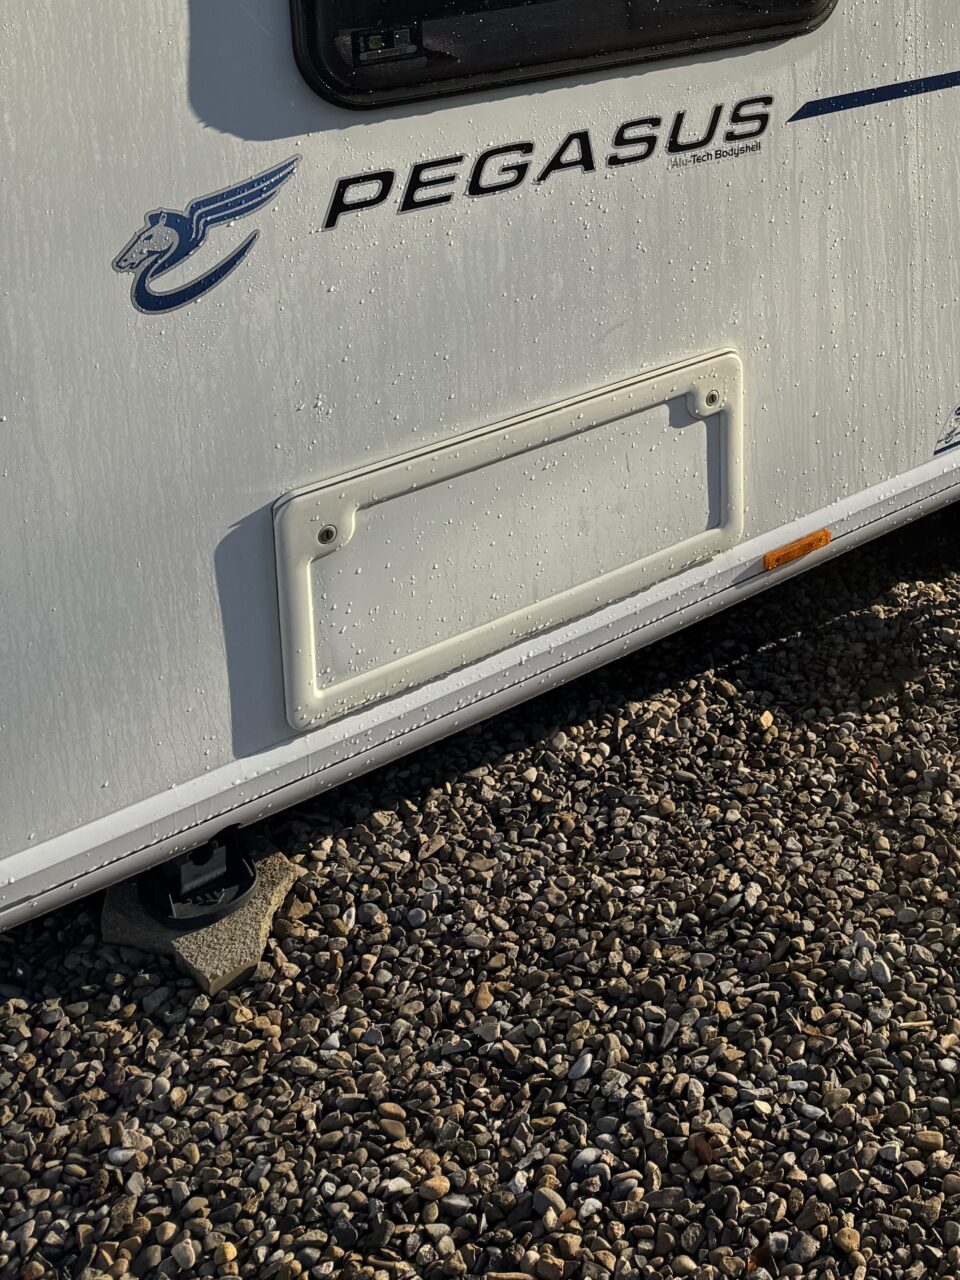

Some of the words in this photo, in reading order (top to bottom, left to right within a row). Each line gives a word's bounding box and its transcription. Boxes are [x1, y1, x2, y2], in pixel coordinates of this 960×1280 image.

[321, 95, 774, 231] PEGASUS
[670, 152, 713, 168] Alu-Tech
[715, 141, 761, 158] Bodyshell
